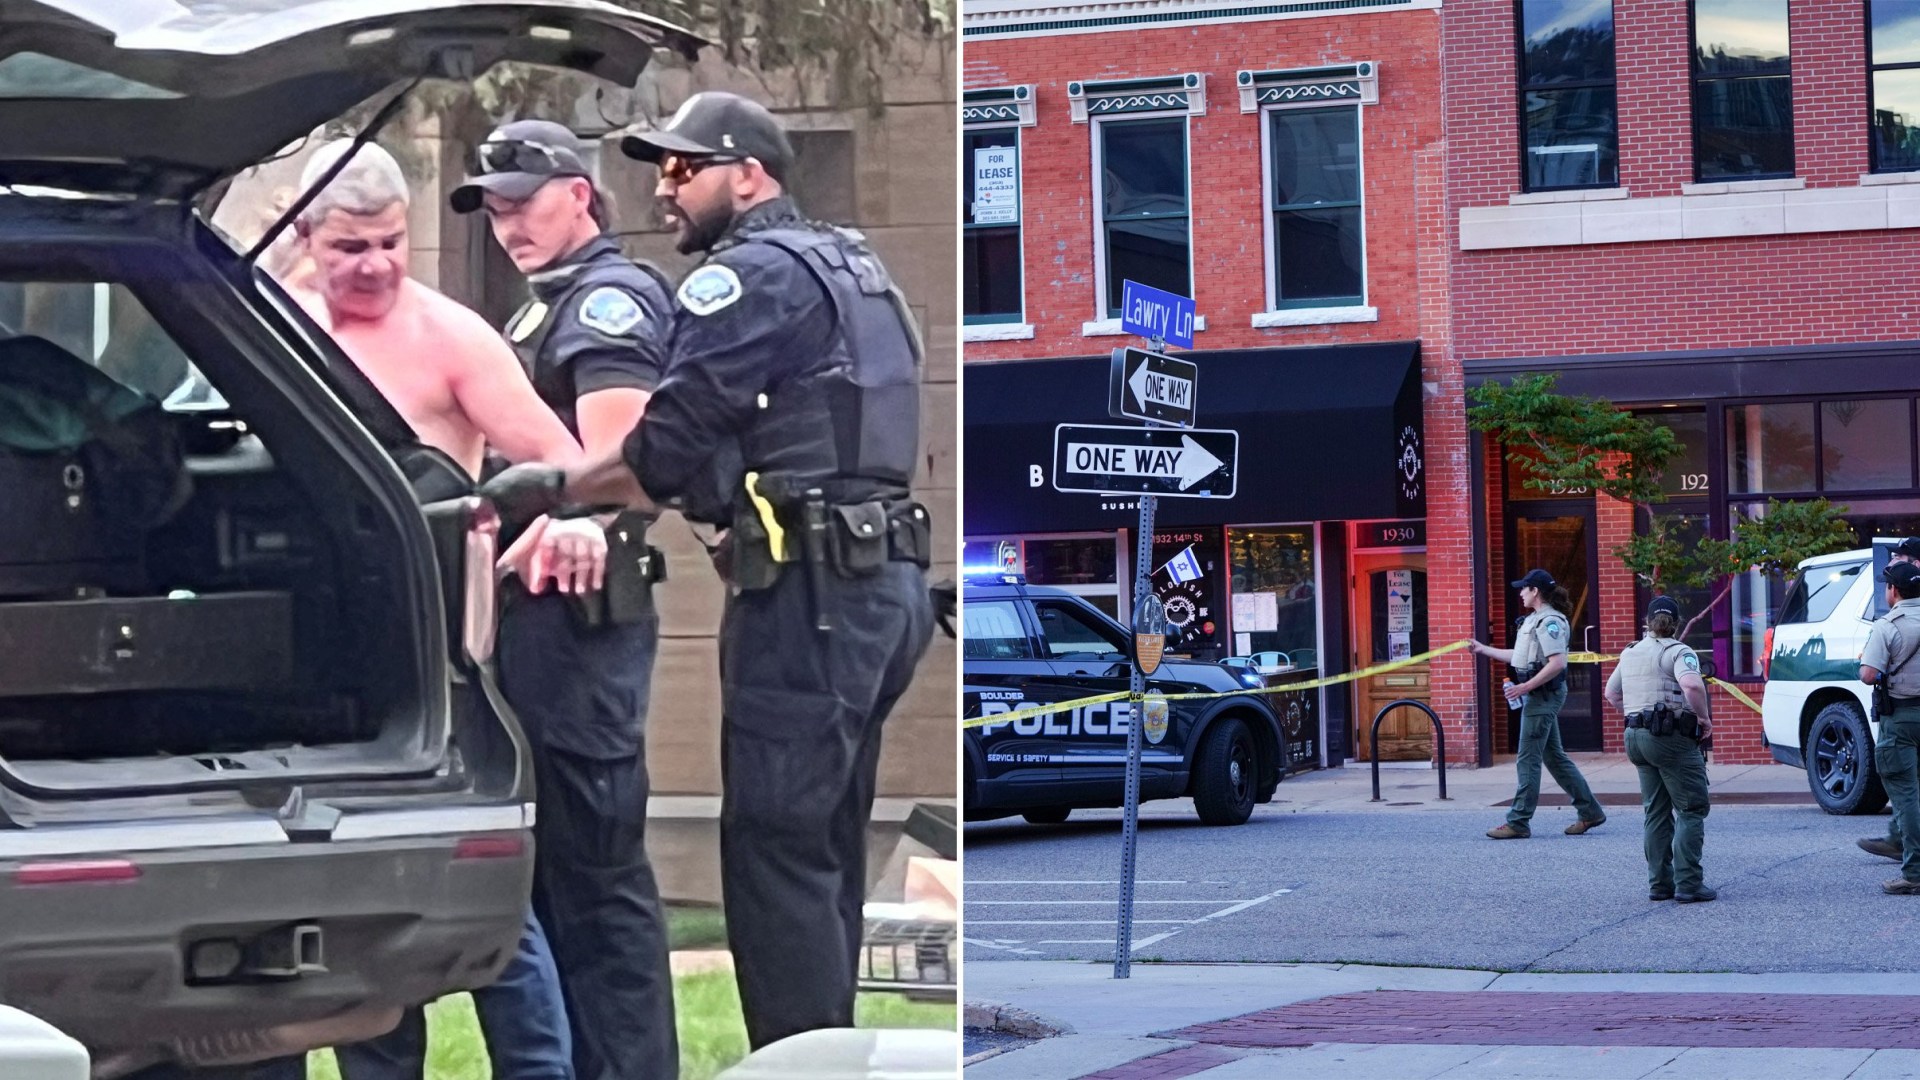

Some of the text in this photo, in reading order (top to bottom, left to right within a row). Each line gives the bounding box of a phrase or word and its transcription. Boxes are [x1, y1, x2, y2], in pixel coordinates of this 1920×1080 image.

[988, 155, 1004, 163] FOR
[979, 167, 1013, 179] LEASE
[1126, 287, 1192, 339] Lawry Ln
[1145, 374, 1188, 405] ONE WAY
[1075, 447, 1183, 474] ONE WAY
[1101, 502, 1141, 510] SUSHI
[1173, 534, 1192, 543] 14th
[1193, 533, 1203, 542] St
[1383, 527, 1415, 541] 1930
[980, 692, 1024, 700] BOULDER
[981, 701, 1130, 736] POLICE
[987, 754, 1015, 762] SERVICE
[1016, 754, 1022, 762] &
